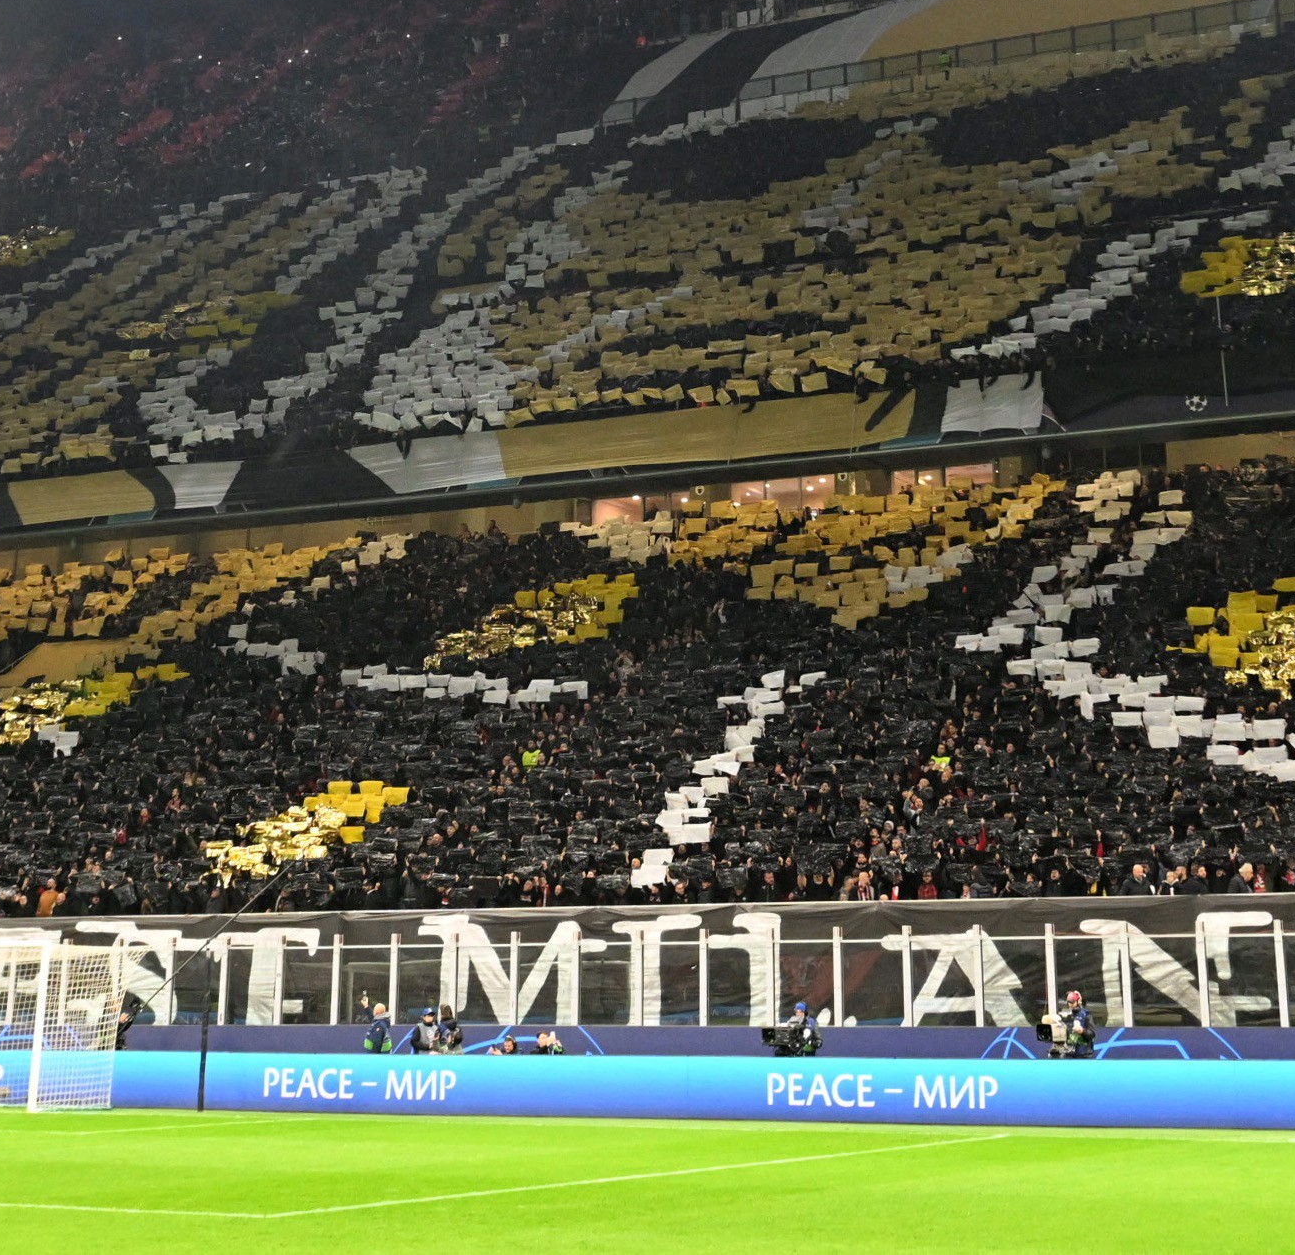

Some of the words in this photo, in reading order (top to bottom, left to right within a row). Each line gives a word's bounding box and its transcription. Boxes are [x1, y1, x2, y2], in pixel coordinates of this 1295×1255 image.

[418, 912, 1273, 1027] MILAN
[263, 1067, 353, 1099] PEACE
[385, 1070, 456, 1101] МИР
[766, 1073, 875, 1108] PEACE
[913, 1075, 998, 1109] МИР
